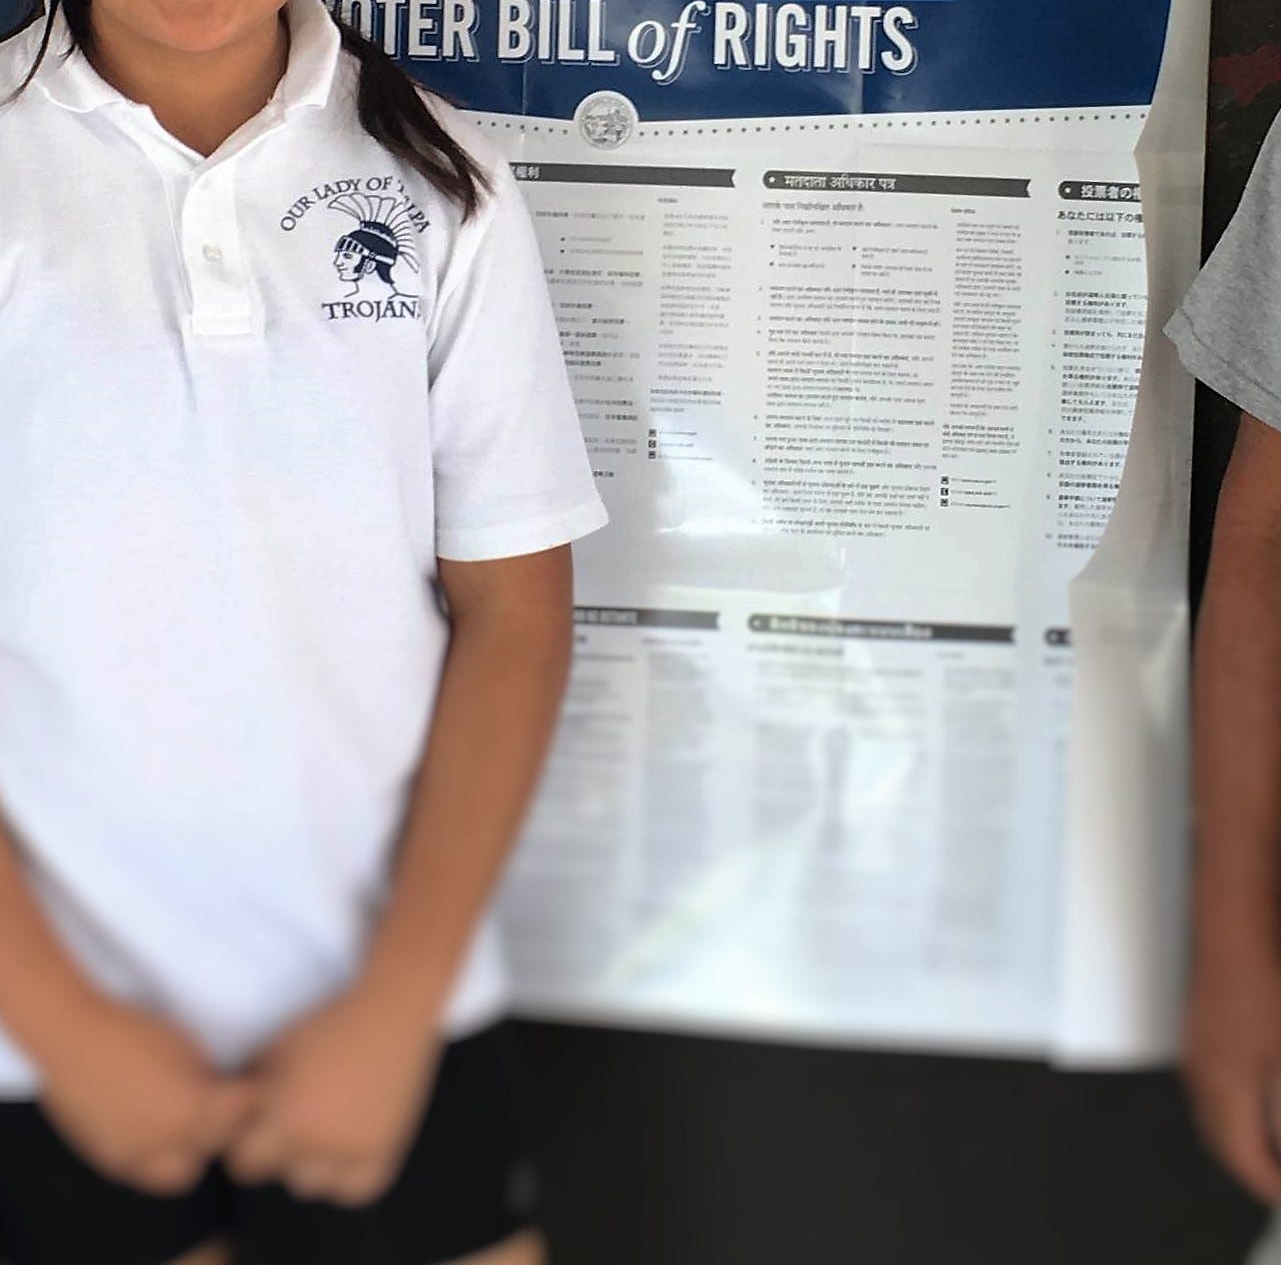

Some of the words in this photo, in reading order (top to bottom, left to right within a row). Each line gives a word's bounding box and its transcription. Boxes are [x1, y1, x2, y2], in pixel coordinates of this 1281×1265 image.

[627, 0, 711, 86] of
[713, 2, 919, 76] RIGHTS
[280, 195, 317, 232] OUR
[312, 178, 362, 201] LADY
[365, 176, 394, 192] OF
